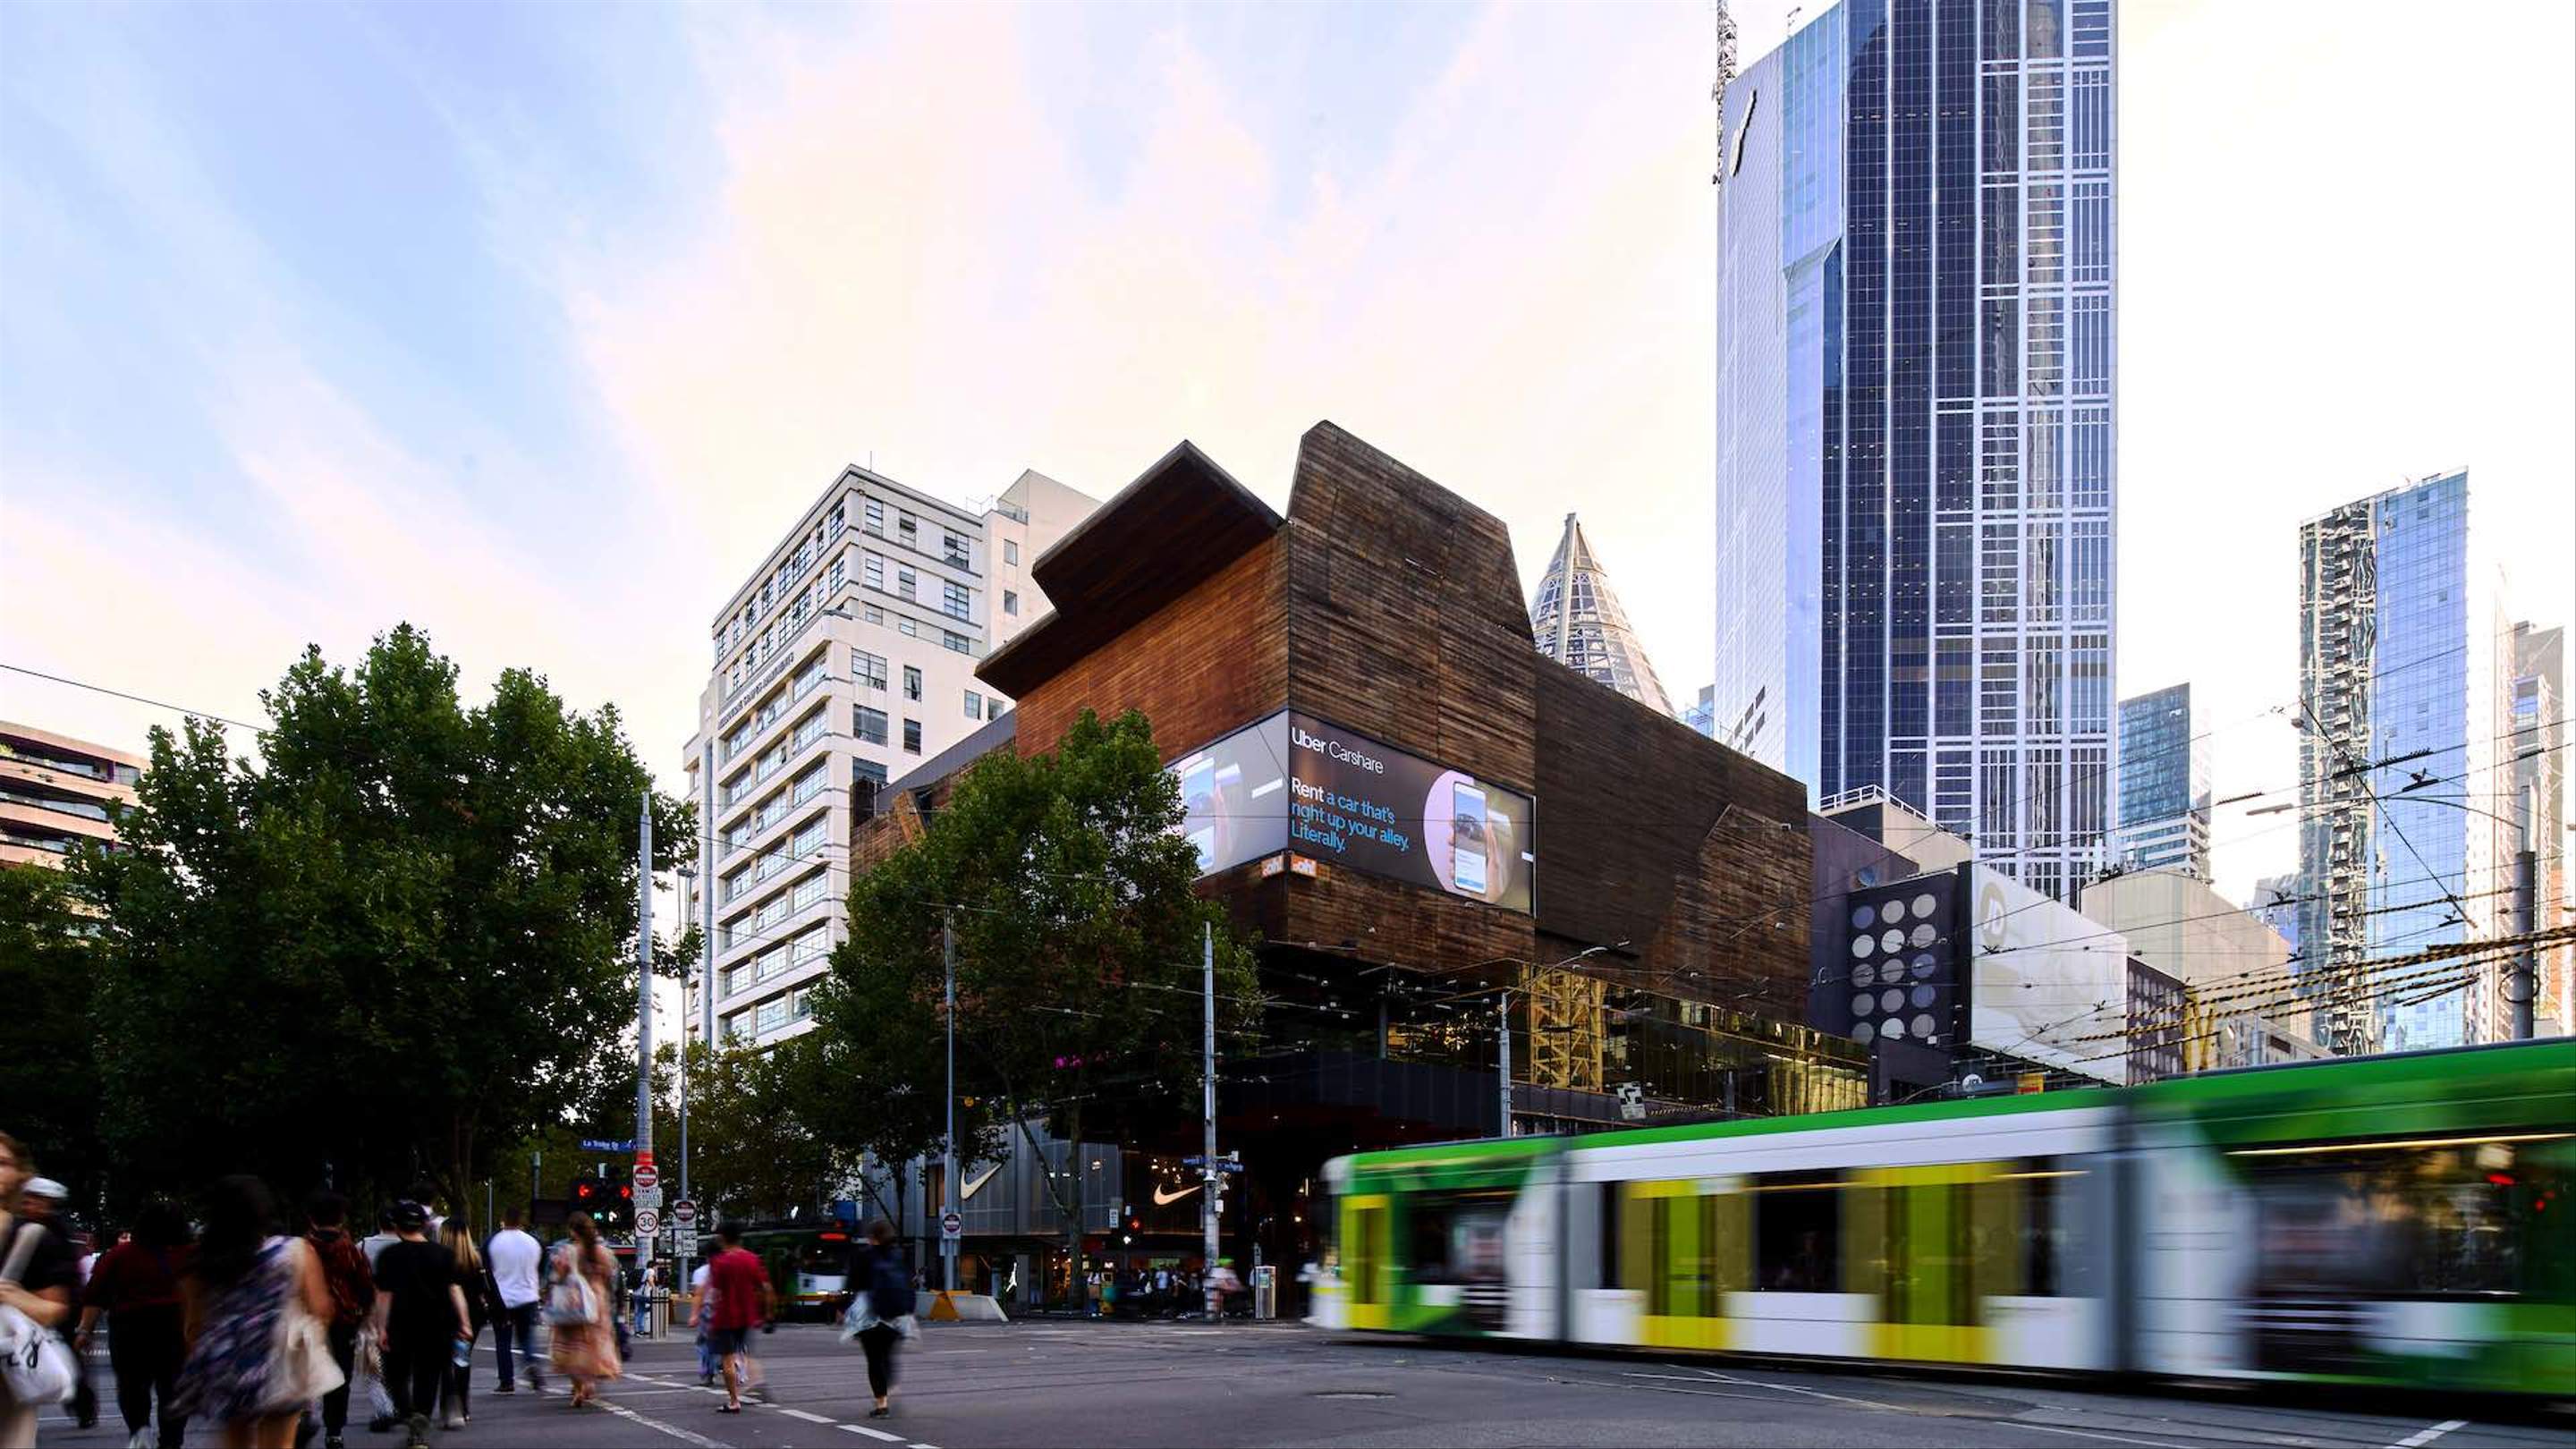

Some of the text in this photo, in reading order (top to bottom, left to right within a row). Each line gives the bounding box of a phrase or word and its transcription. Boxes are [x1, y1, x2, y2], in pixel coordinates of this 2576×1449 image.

[1292, 726, 1384, 774] Uber Carshare
[1292, 777, 1395, 825] Rent a car that's
[1292, 802, 1410, 852] right up your alley.
[1292, 820, 1346, 852] Literally.
[640, 1216, 655, 1227] 30
